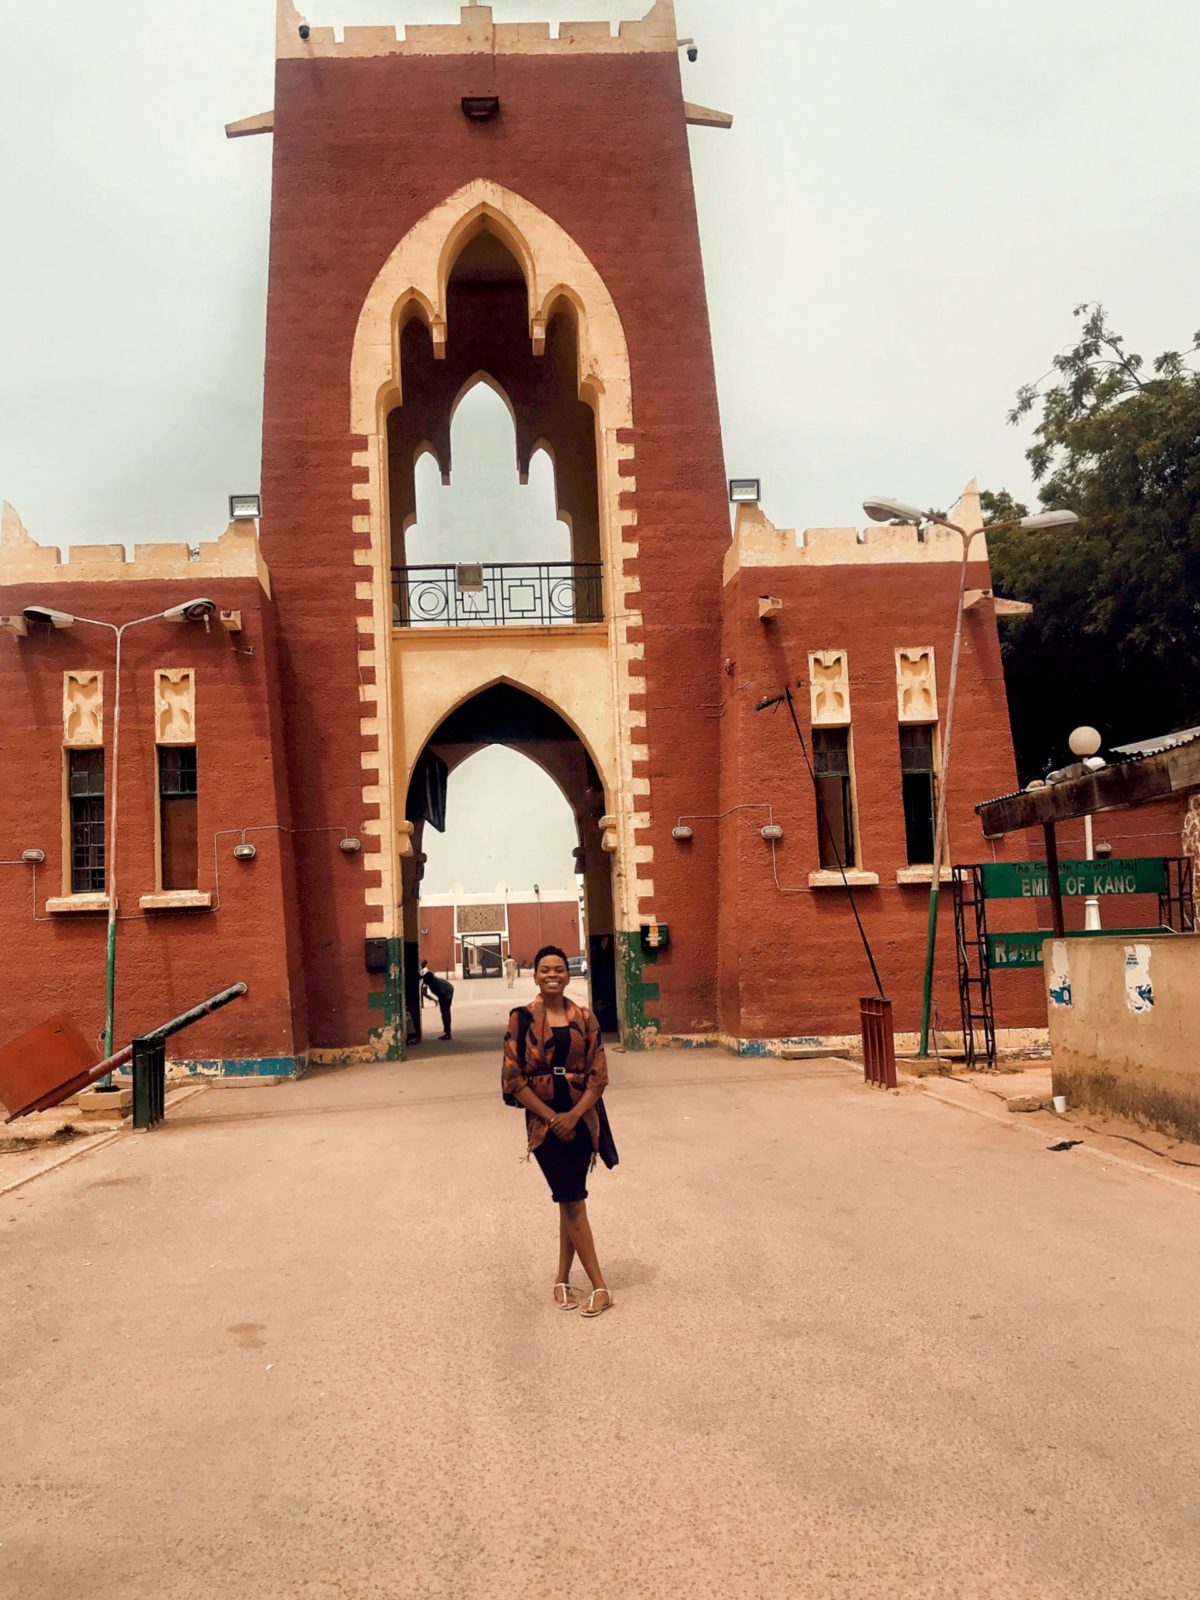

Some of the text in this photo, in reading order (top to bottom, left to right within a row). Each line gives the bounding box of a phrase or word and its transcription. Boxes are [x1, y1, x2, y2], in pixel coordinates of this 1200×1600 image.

[1011, 863, 1030, 873] The
[1034, 861, 1073, 871] Emate
[1119, 858, 1137, 871] And
[1022, 875, 1136, 896] EMI OF KANO
